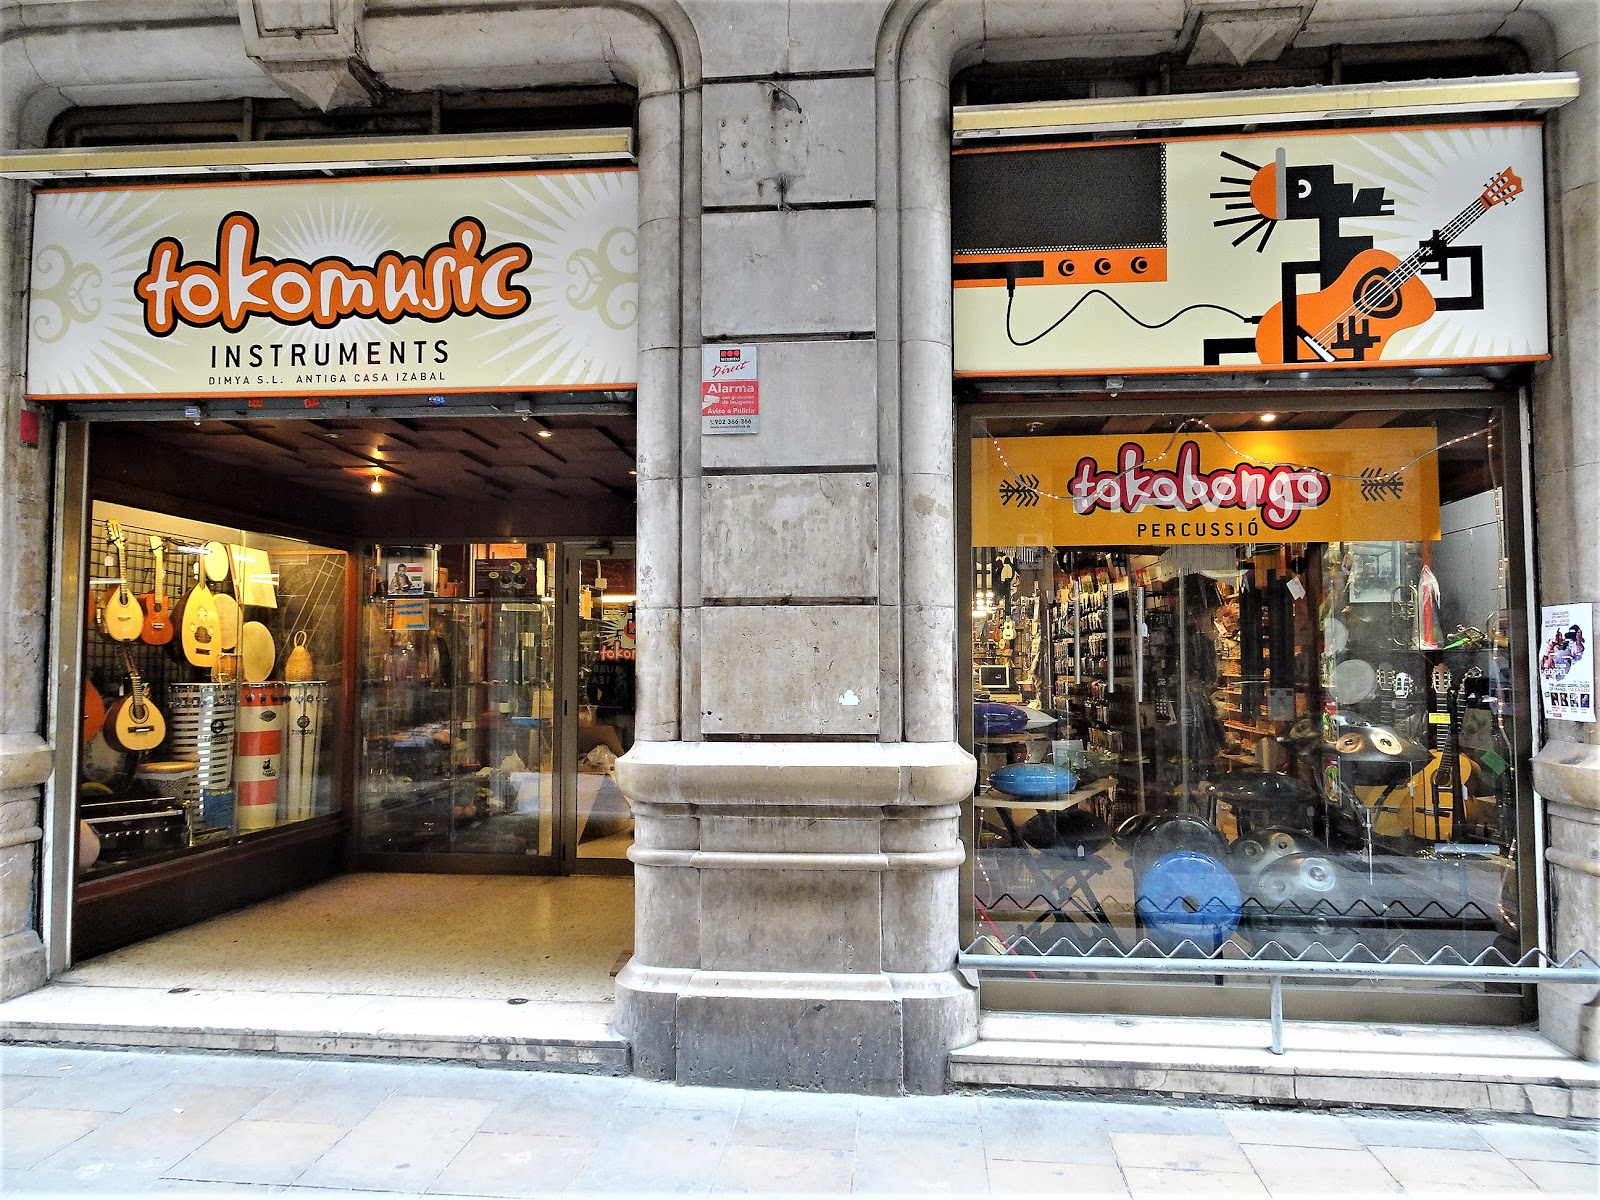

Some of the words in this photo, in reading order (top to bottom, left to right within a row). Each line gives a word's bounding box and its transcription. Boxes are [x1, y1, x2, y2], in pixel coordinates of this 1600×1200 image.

[138, 213, 530, 336] tokomusic
[211, 340, 448, 368] INSTRUMENTS
[209, 376, 250, 385] DIMYA
[257, 375, 284, 384] S.L.
[296, 374, 346, 384] ANTIGA
[354, 373, 388, 382] CASA
[396, 372, 446, 382] IZABAL
[708, 383, 754, 394] Alarma
[1067, 441, 1330, 529] tokobongo
[1138, 518, 1258, 537] PERCUSSIÓ
